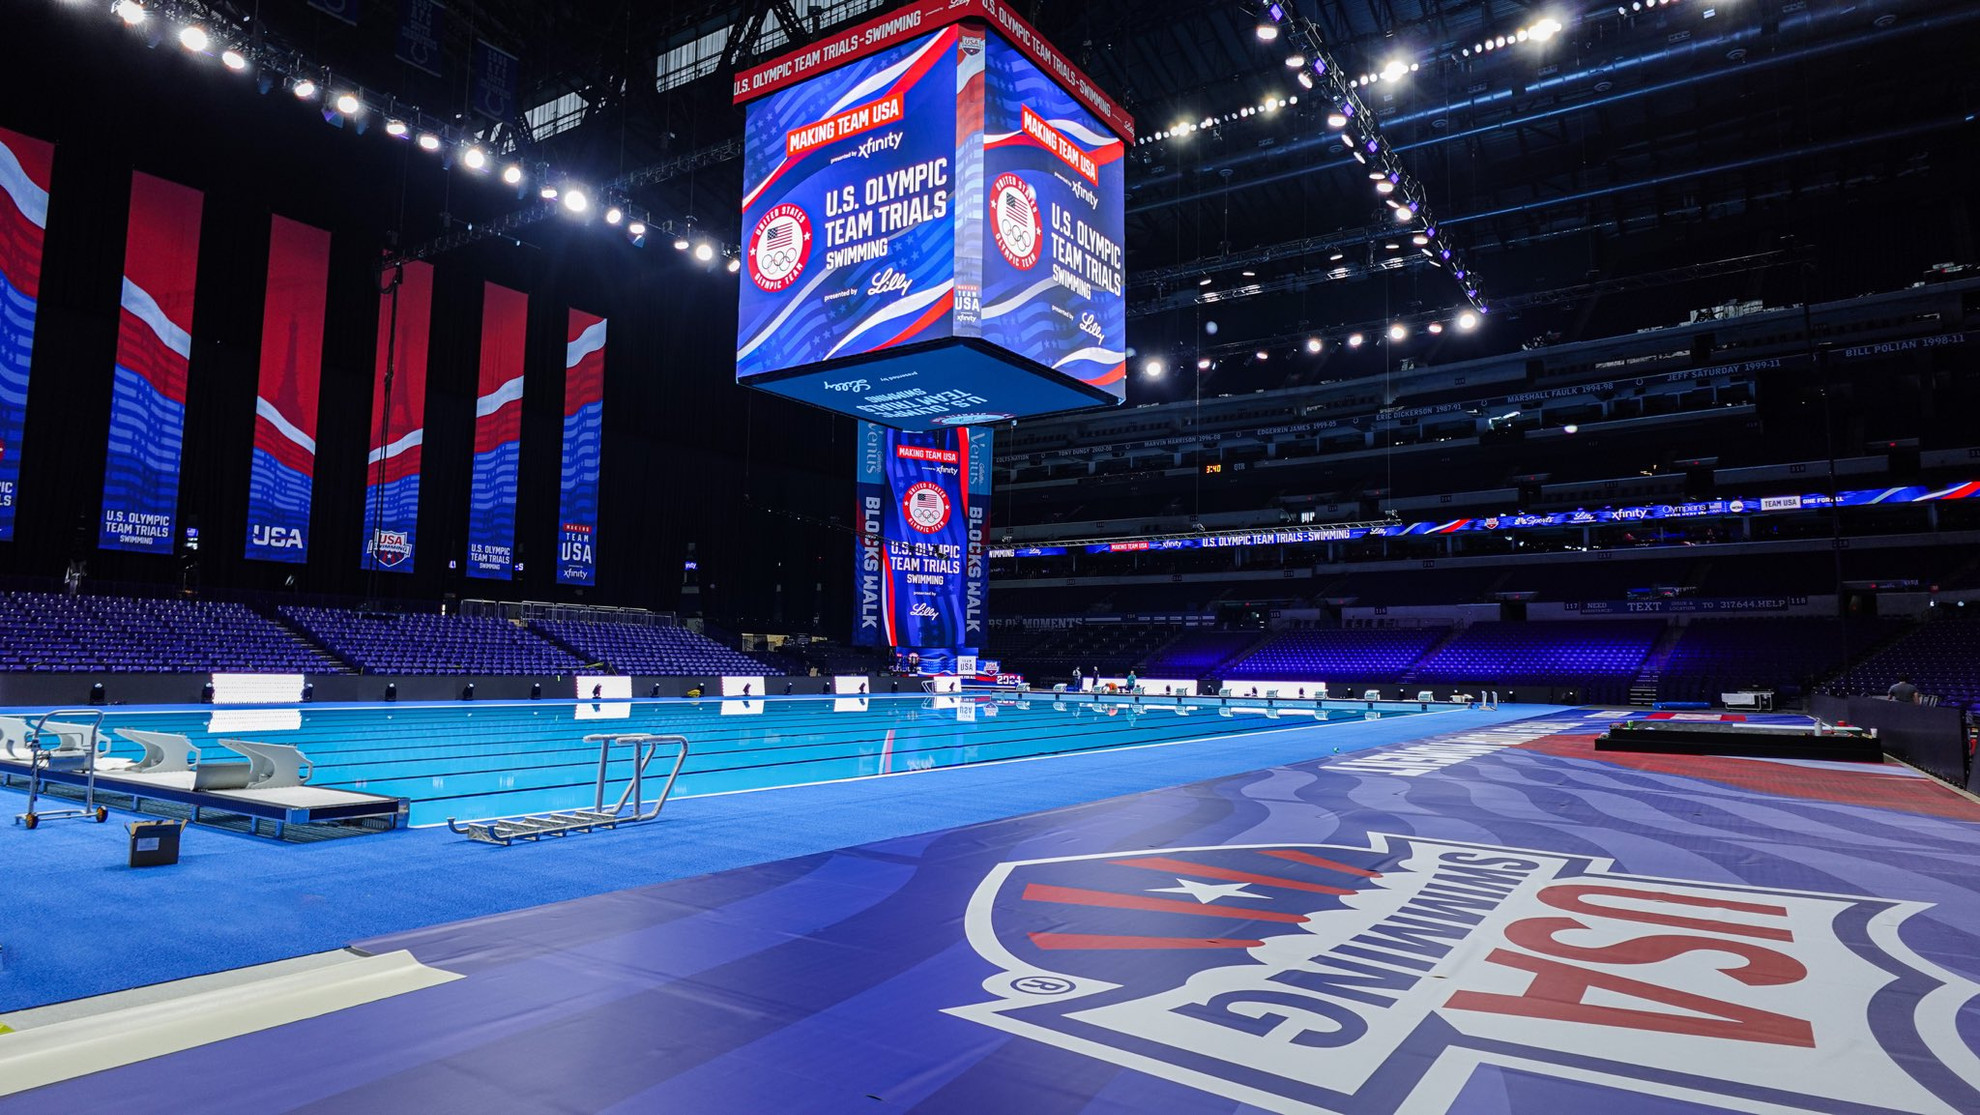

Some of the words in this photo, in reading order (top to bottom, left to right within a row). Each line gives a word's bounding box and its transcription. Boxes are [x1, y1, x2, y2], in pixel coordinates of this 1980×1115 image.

[998, 6, 1031, 46] OLYMPIC
[1032, 36, 1052, 66] TEAM
[734, 77, 750, 96] U.S.
[752, 61, 792, 90] OLYMPIC
[794, 50, 820, 72] TEAM
[790, 122, 835, 152] MAKING
[837, 108, 869, 135] TEAM
[872, 98, 900, 122] USA
[830, 153, 851, 164] presented
[858, 132, 904, 158] xfinity
[1024, 111, 1057, 150] MAKING
[1058, 138, 1079, 168] TEAM
[1080, 156, 1096, 180] USA
[826, 185, 860, 218] U.S.
[865, 157, 948, 206] OLYMPIC
[995, 175, 1017, 192] UNITED
[1072, 180, 1098, 210] xfinity
[754, 208, 780, 236] UNITED
[781, 206, 806, 224] STATES
[824, 210, 873, 248] TEAM
[878, 190, 947, 233] TRIALS
[1051, 202, 1074, 240] U.S.
[1076, 220, 1121, 270] OLYMPIC
[826, 238, 888, 270] SWIMMING
[995, 233, 1020, 267] OLYMPIC
[1022, 252, 1037, 268] TEAM
[1051, 232, 1083, 274] TEAM
[1084, 254, 1121, 297] TRIALS
[754, 272, 782, 290] OLYMPIC
[784, 262, 804, 285] TEAM
[824, 290, 850, 302] presented
[850, 288, 858, 296] by
[867, 267, 913, 296] Lilly
[1052, 263, 1092, 300] SWIMMING
[954, 296, 980, 312] USA
[1052, 304, 1068, 318] presented
[1079, 312, 1105, 346] Lilly
[1845, 347, 1872, 358] BILL
[1874, 341, 1918, 354] POLIAN
[1922, 334, 1966, 348] 1998-11
[1666, 370, 1689, 382] JEFF
[1691, 364, 1740, 378] SATURDAY
[1744, 360, 1781, 372] 1999-11
[824, 379, 871, 392] Lilly
[1507, 391, 1550, 404] MARSHALL
[1552, 387, 1578, 398] FAULK
[1581, 382, 1614, 395] 1994-98
[864, 388, 927, 403] SWIMMING
[916, 388, 972, 408] TEAM
[856, 400, 922, 413] TRIALS
[1376, 411, 1392, 421] ERIC
[1393, 407, 1432, 419] DICKERSON
[1436, 404, 1462, 414] 1987-91
[1289, 424, 1310, 434] JAMES
[1144, 439, 1166, 448] MARVIN
[1168, 436, 1196, 445] HARRISON
[899, 447, 924, 458] MAKING
[924, 450, 942, 460] TEAM
[942, 451, 956, 462] USA
[970, 432, 986, 485] Venus
[936, 465, 958, 476] xfinity
[1206, 464, 1222, 474] 3:40
[908, 483, 926, 496] UNITED
[928, 483, 946, 499] STATES
[1662, 504, 1706, 514] Olympians
[1764, 500, 1782, 508] TEAM
[1783, 498, 1797, 507] USA
[1816, 496, 1830, 504] FOR
[106, 510, 126, 522] U.S.
[128, 512, 170, 526] OLYMPIC
[1525, 515, 1554, 526] Sports
[1573, 512, 1595, 521] Lilly
[1612, 508, 1647, 520] xfinity
[106, 522, 132, 534] TEAM
[135, 524, 169, 538] TRIALS
[908, 518, 929, 533] OLYMPIC
[932, 520, 945, 532] TEAM
[1370, 527, 1388, 536] Lilly
[120, 535, 153, 545] SWIMMING
[252, 524, 303, 549] USA
[380, 534, 402, 545] USA
[566, 532, 589, 542] TEAM
[864, 496, 881, 573] BLOCKS
[968, 506, 983, 579] BLOCKS
[1202, 538, 1217, 548] U.S.
[1218, 536, 1251, 546] OLYMPIC
[1252, 534, 1274, 544] TEAM
[471, 544, 484, 553] U.S.
[484, 545, 510, 556] OLYMPIC
[562, 542, 592, 564] USA
[890, 540, 912, 556] U.S.
[1127, 542, 1138, 550] TEAM
[1162, 540, 1182, 550] xfinity
[470, 552, 488, 562] TEAM
[489, 554, 510, 564] TRIALS
[479, 562, 500, 570] SWIMMING
[890, 556, 920, 572] TEAM
[923, 558, 960, 574] TRIALS
[564, 568, 588, 580] xfinity
[906, 573, 944, 586] SWIMMING
[862, 576, 878, 629] WALK
[910, 602, 939, 620] Lilly
[966, 582, 982, 633] WALK
[1626, 601, 1662, 611] TEXT
[1720, 599, 1786, 610] 317.644.HELP
[960, 663, 974, 671] USA
[1168, 850, 1540, 1050] SWIMMING
[1443, 883, 1817, 1049] USA
